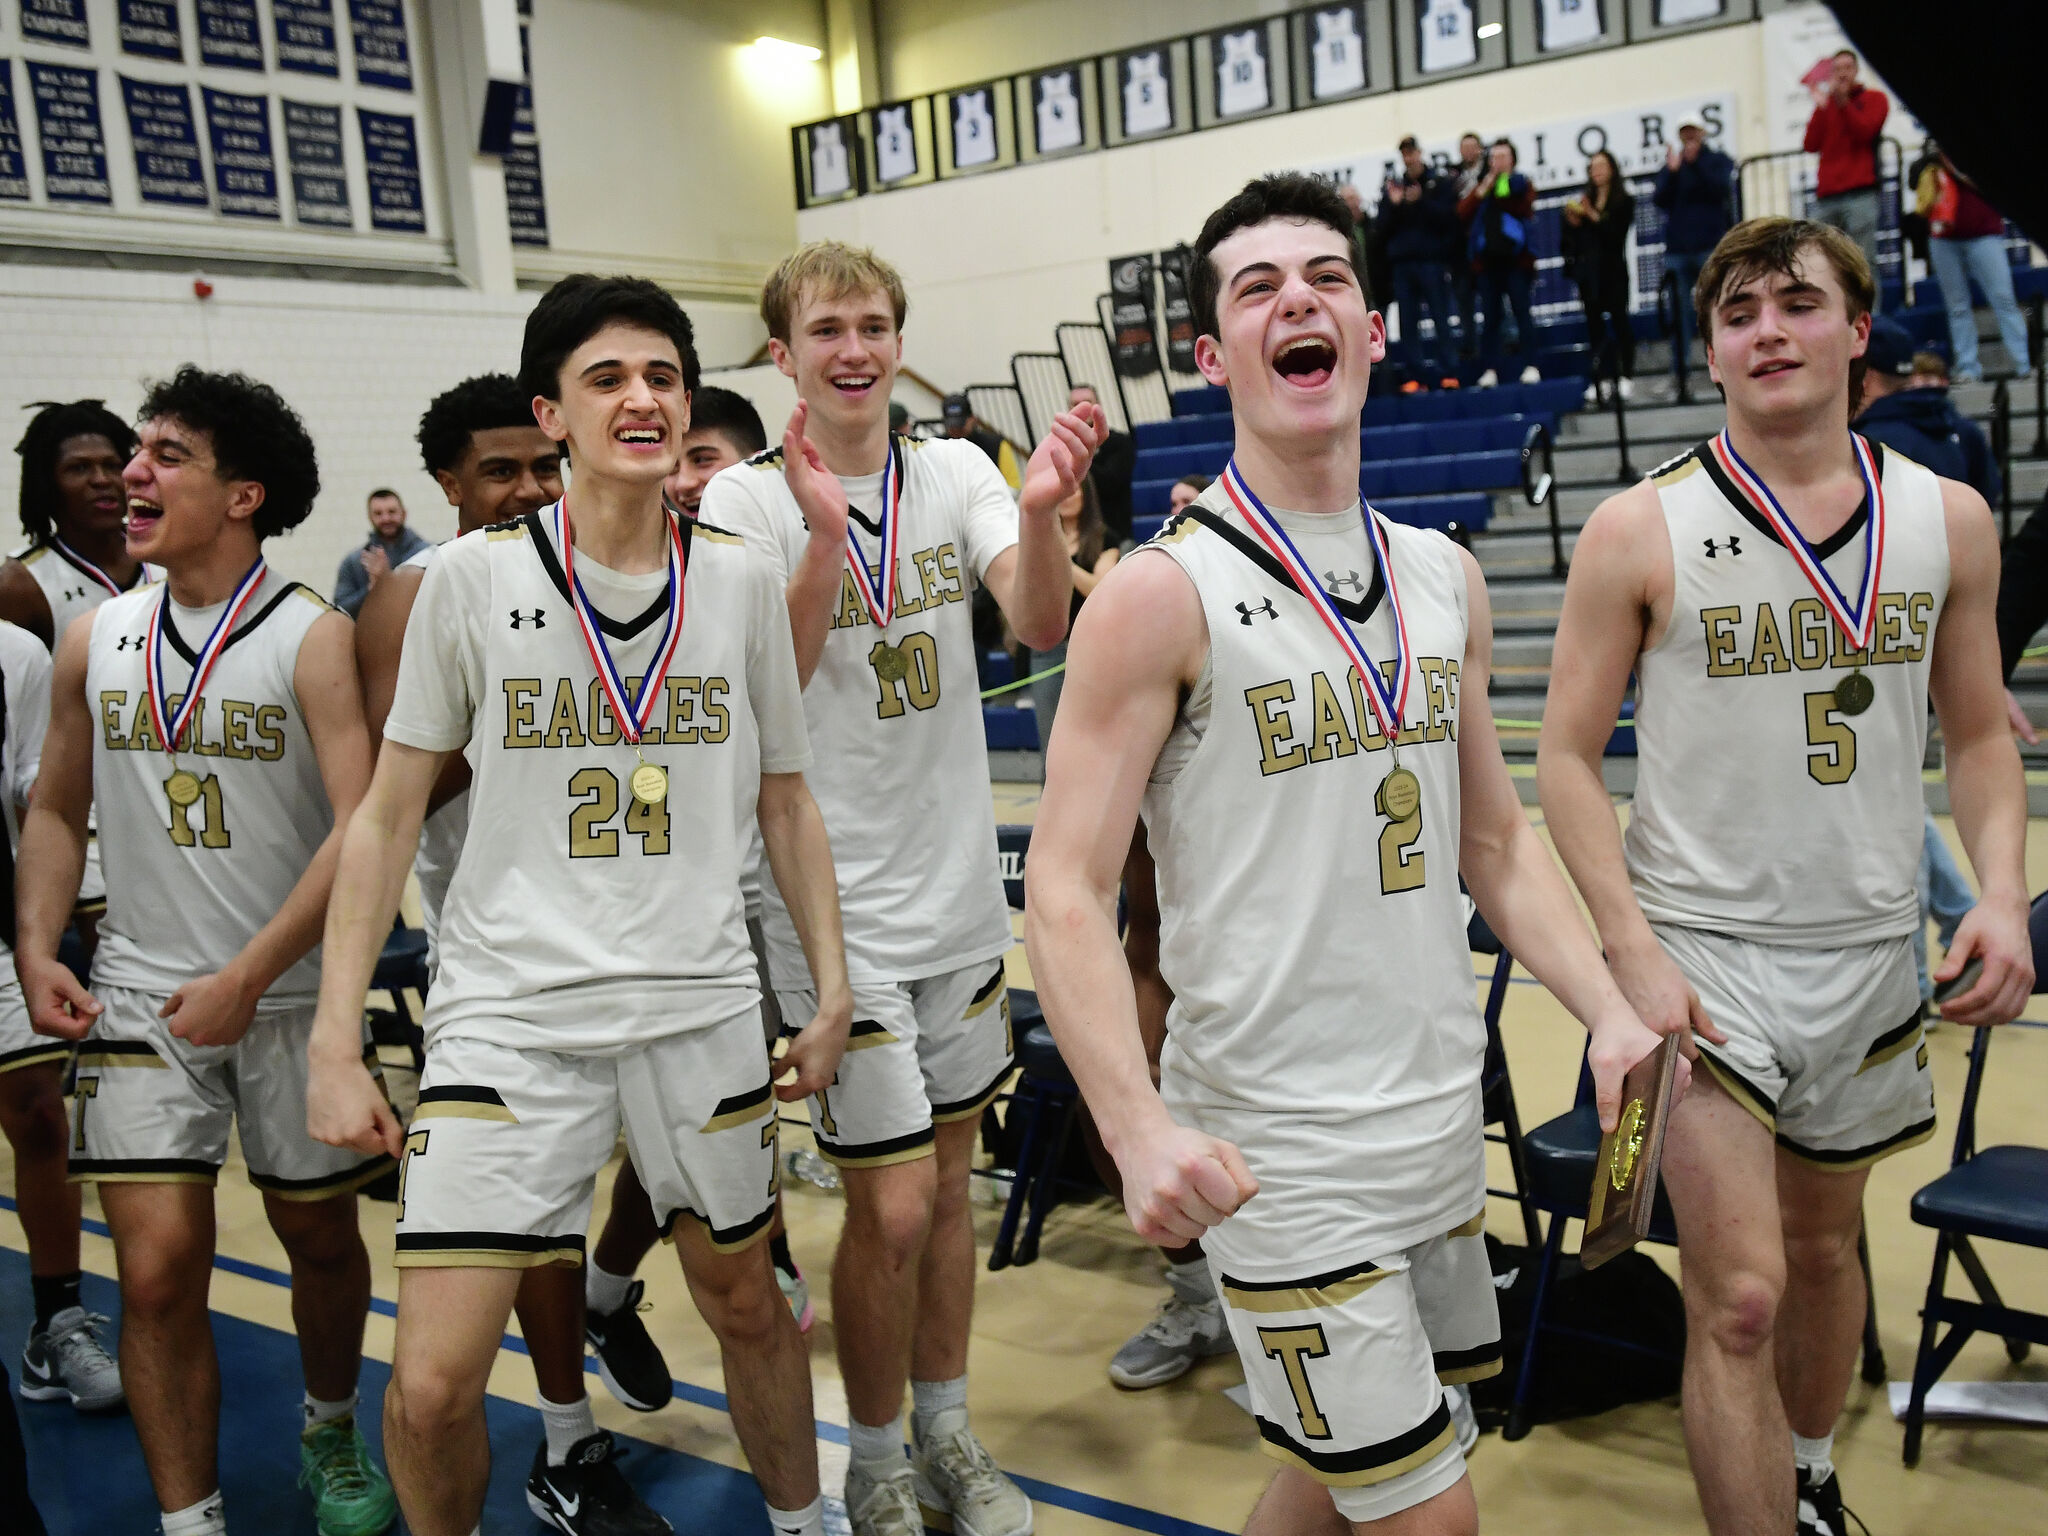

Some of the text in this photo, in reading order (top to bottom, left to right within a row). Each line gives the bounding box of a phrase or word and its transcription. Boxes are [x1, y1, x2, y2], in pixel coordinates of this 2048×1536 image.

[868, 631, 940, 719] 10
[1804, 690, 1857, 785] 5
[163, 773, 231, 848] 11
[568, 766, 671, 858] 24
[1374, 777, 1425, 896] 2
[74, 1076, 99, 1151] T
[1256, 1322, 1334, 1441] T
